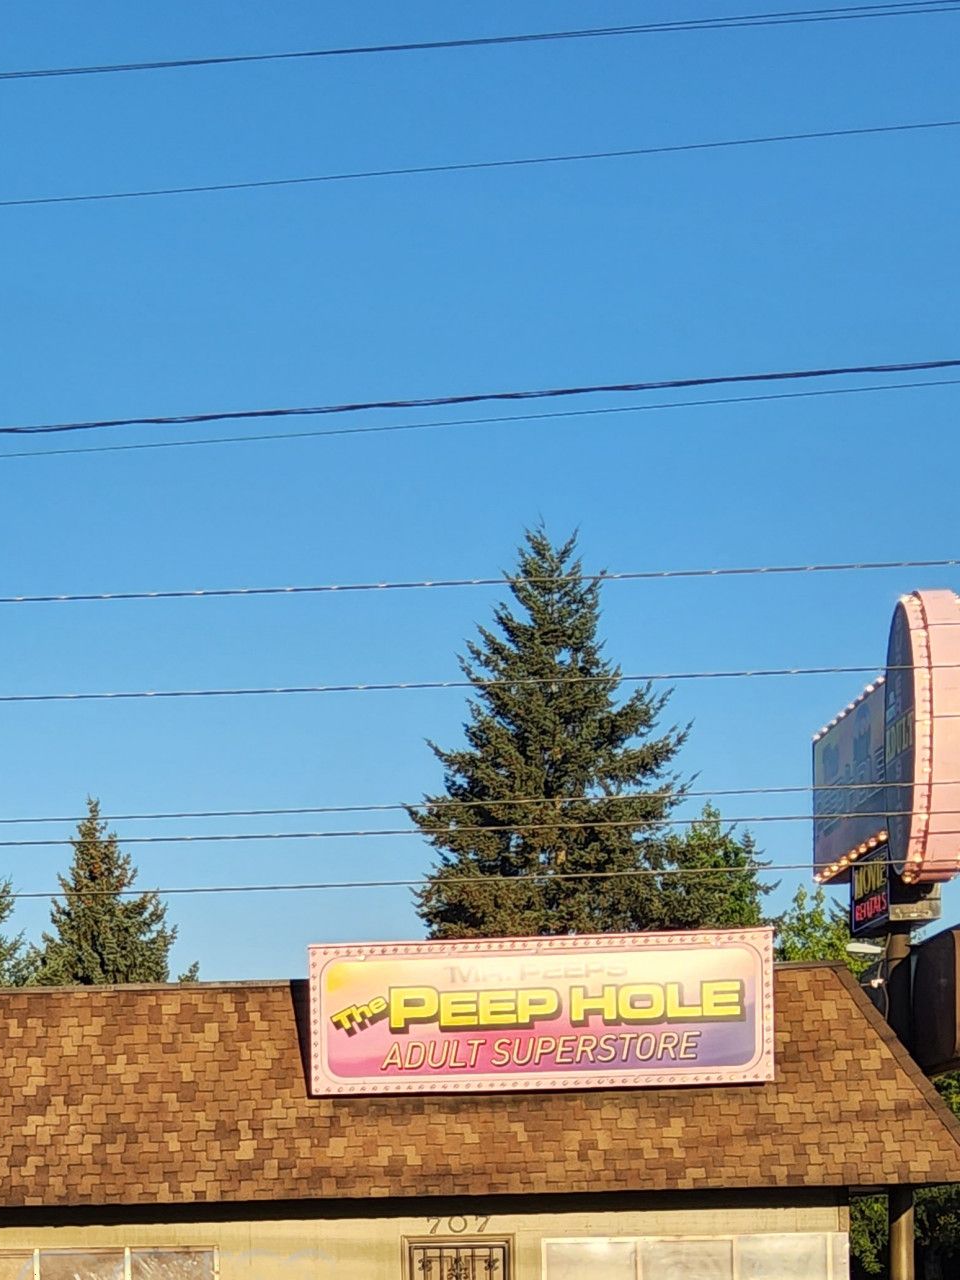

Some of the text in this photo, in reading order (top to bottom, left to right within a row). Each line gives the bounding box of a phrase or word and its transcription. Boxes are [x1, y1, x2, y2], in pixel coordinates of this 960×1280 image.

[885, 711, 914, 764] ADULT
[854, 852, 887, 900] MOVIE
[443, 961, 628, 984] MR. PEEPS
[331, 979, 746, 1037] The PEEP HOLE
[380, 1032, 702, 1071] ADULT SUPERSTORE
[426, 1215, 491, 1234] 707
